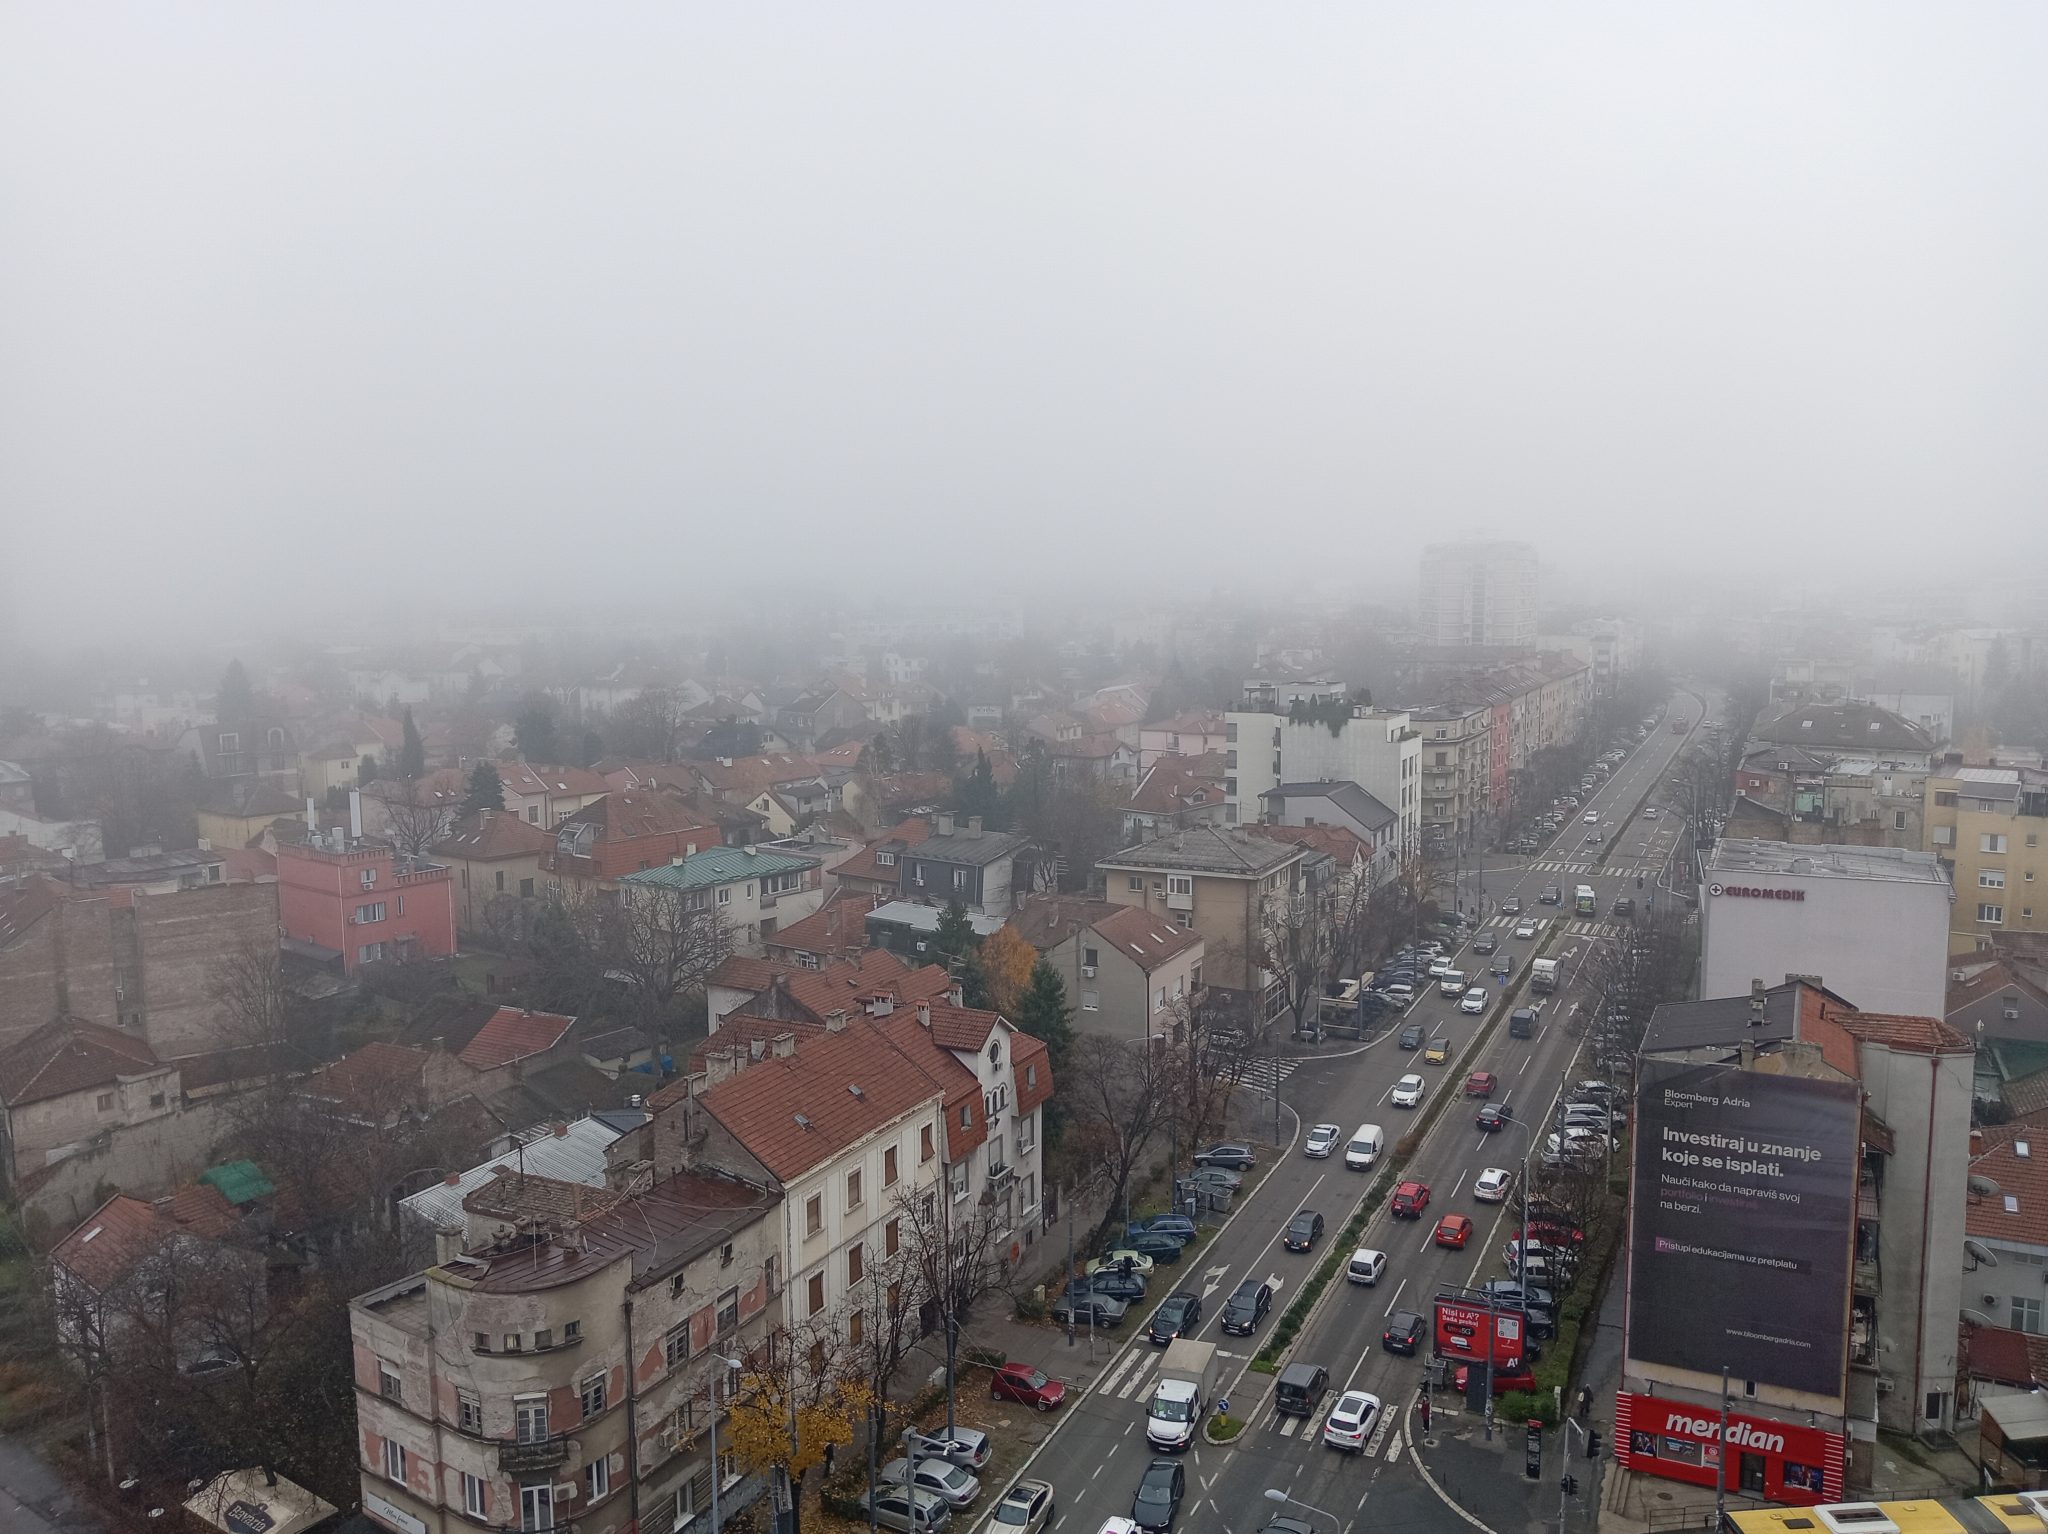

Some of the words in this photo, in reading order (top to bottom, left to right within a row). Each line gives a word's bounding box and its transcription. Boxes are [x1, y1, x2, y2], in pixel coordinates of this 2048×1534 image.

[1725, 886, 1805, 902] EUROMEDIK
[1664, 1089, 1719, 1106] Bloomberg
[1722, 1096, 1751, 1108] Adria
[1664, 1098, 1693, 1109] Expert
[1663, 1126, 1744, 1153] Investiraj
[1747, 1141, 1759, 1153] u
[1761, 1143, 1822, 1162] znanje
[1662, 1146, 1700, 1167] koje
[1701, 1156, 1723, 1169] se
[1726, 1156, 1784, 1177] isplati.
[1661, 1173, 1691, 1187] Nauči
[1692, 1178, 1717, 1190] kako
[1718, 1182, 1732, 1193] da
[1733, 1186, 1778, 1199] napraviš
[1779, 1192, 1801, 1204] svoj
[1660, 1200, 1673, 1209] na
[1674, 1200, 1702, 1214] berzi.
[1659, 1240, 1691, 1253] Pristupi
[1691, 1246, 1745, 1262] edukacijama
[1745, 1255, 1757, 1264] uz
[1757, 1257, 1798, 1270] pretplatu
[1441, 1307, 1458, 1317] Nisi
[228, 1505, 266, 1532] Bavaria
